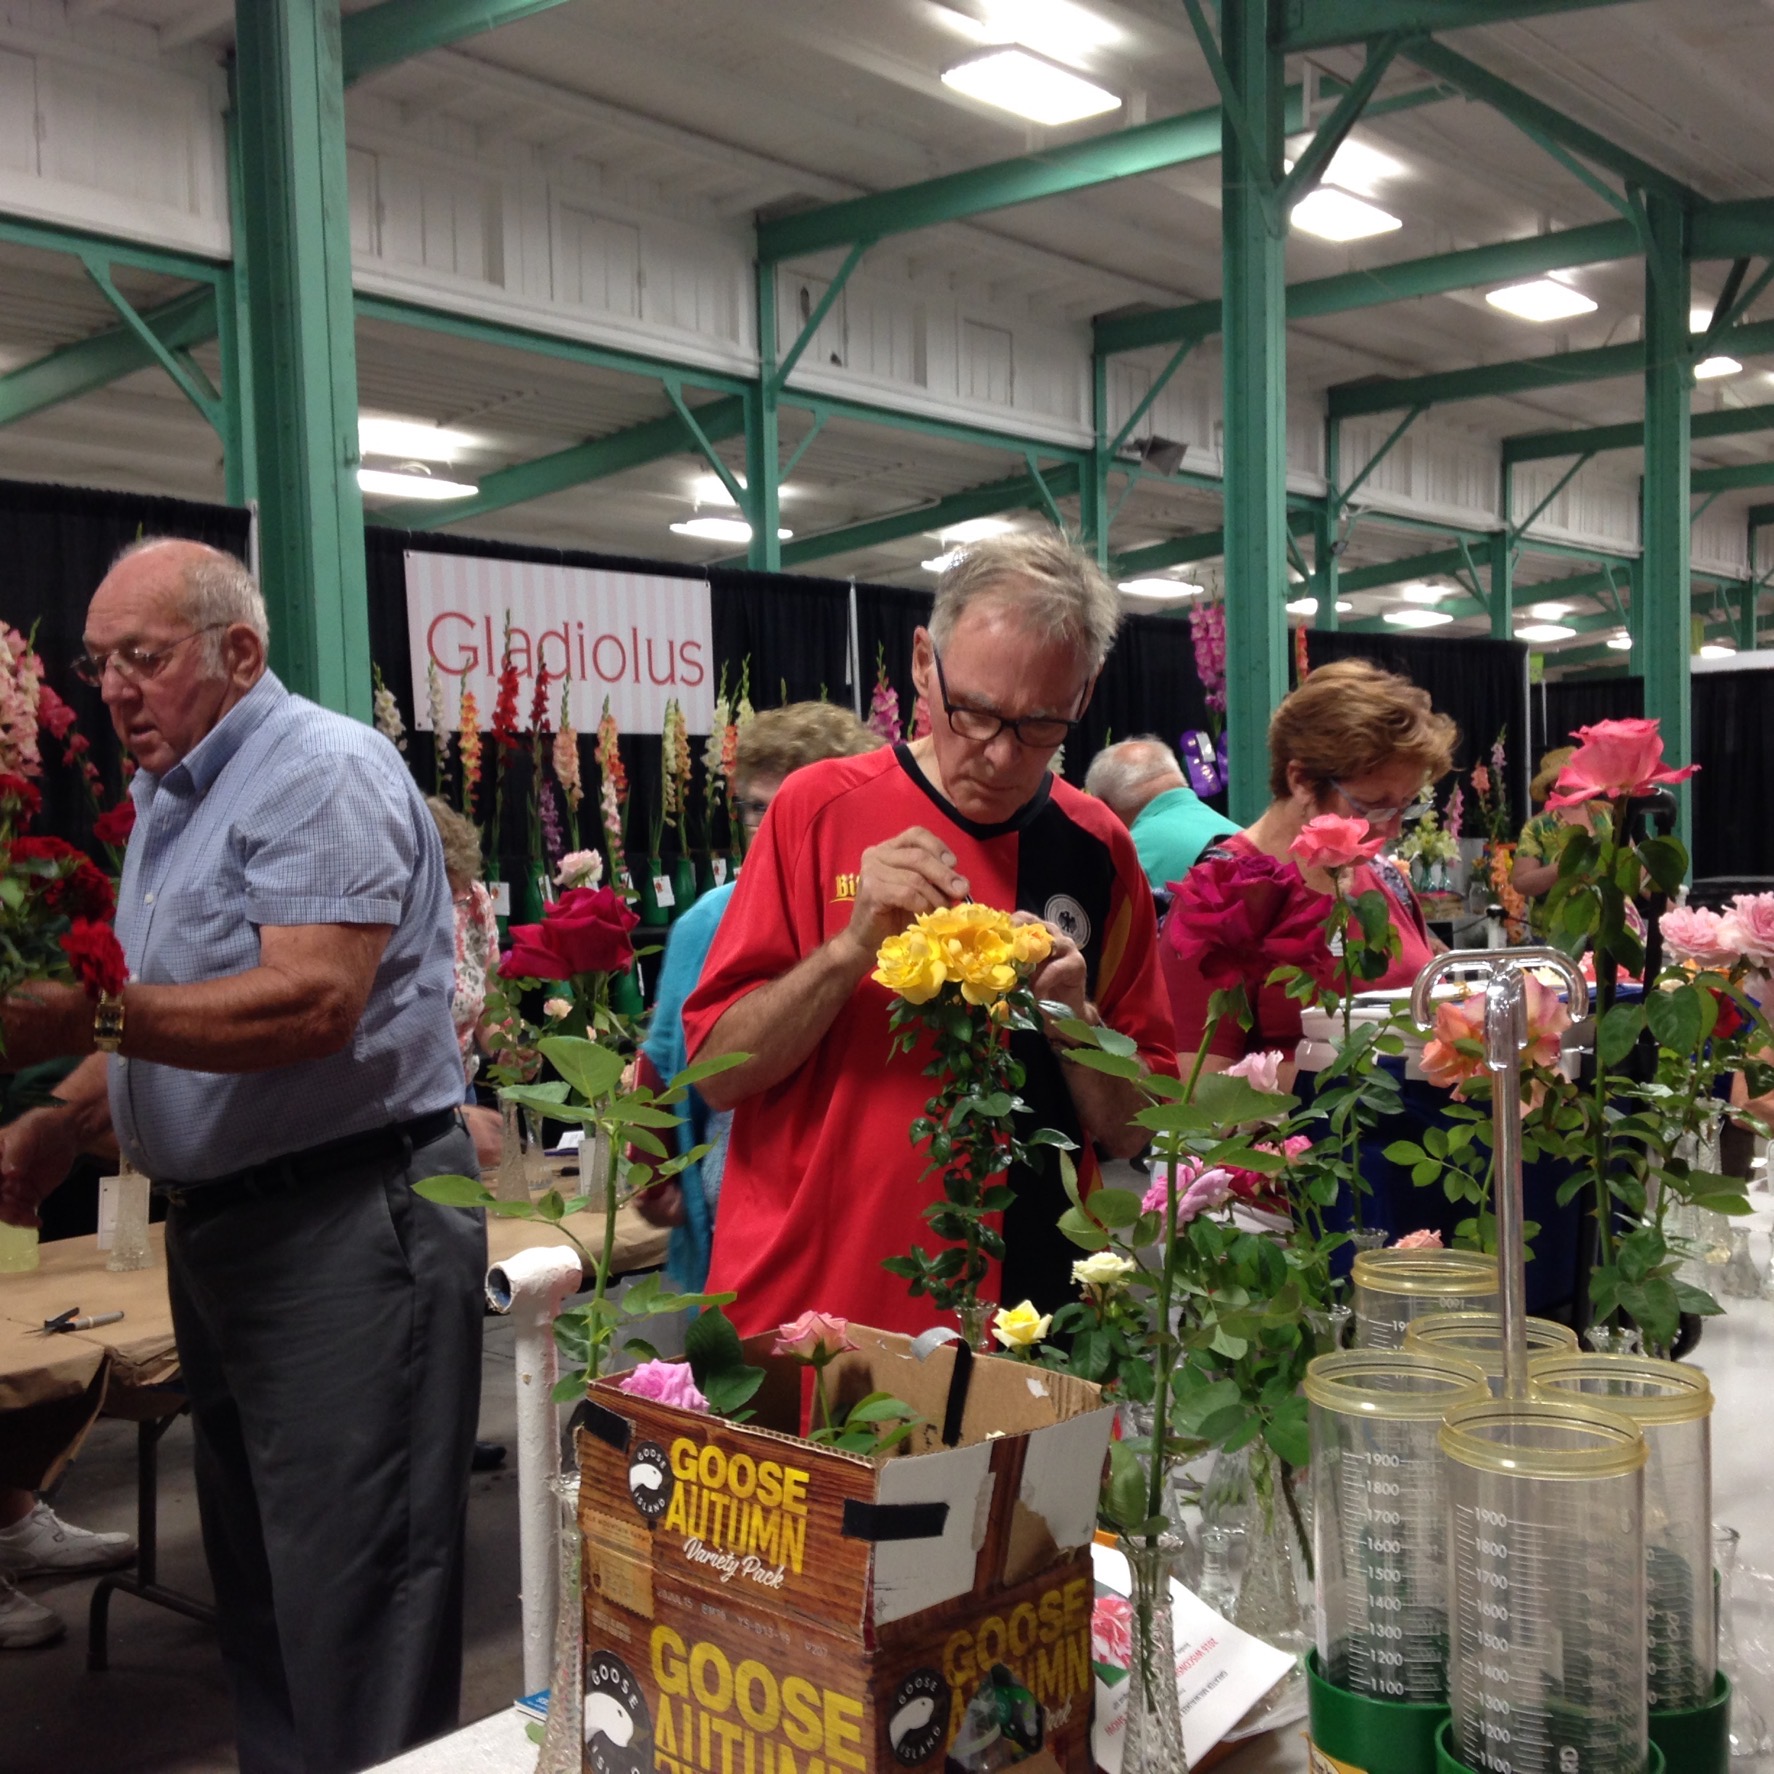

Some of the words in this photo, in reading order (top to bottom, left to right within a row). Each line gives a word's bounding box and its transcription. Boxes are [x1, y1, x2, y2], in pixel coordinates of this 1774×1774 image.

[426, 611, 704, 687] Gladiolus
[637, 1448, 667, 1470] GOOSE
[1366, 1452, 1400, 1468] 1900
[670, 1437, 811, 1516] GOOSE
[1366, 1480, 1400, 1496] 1800
[634, 1491, 666, 1514] ISLAND
[665, 1480, 807, 1576] AUTUMN
[1367, 1508, 1400, 1525] 1700
[1475, 1506, 1508, 1528] 1900
[1367, 1537, 1400, 1553] 1600
[1475, 1536, 1508, 1559] 1800
[683, 1537, 740, 1583] Variety
[741, 1555, 785, 1590] Pack
[1368, 1565, 1401, 1582] 1500
[1475, 1567, 1508, 1590] 1700
[1368, 1594, 1402, 1611] 1400
[1477, 1599, 1509, 1621] 1600
[943, 1578, 1087, 1687] GOOSE
[1370, 1622, 1402, 1640] 1300
[1478, 1630, 1509, 1653] 1500
[1370, 1649, 1404, 1667] 1200
[591, 1664, 639, 1710] GOOSE
[898, 1677, 938, 1705] GOOSE
[1371, 1678, 1405, 1696] 1100
[650, 1624, 867, 1774] GOOSE
[1479, 1691, 1510, 1715] 1300
[900, 1725, 941, 1760] ISLAND
[1480, 1719, 1511, 1744] 1200
[1481, 1750, 1512, 1774] 1100
